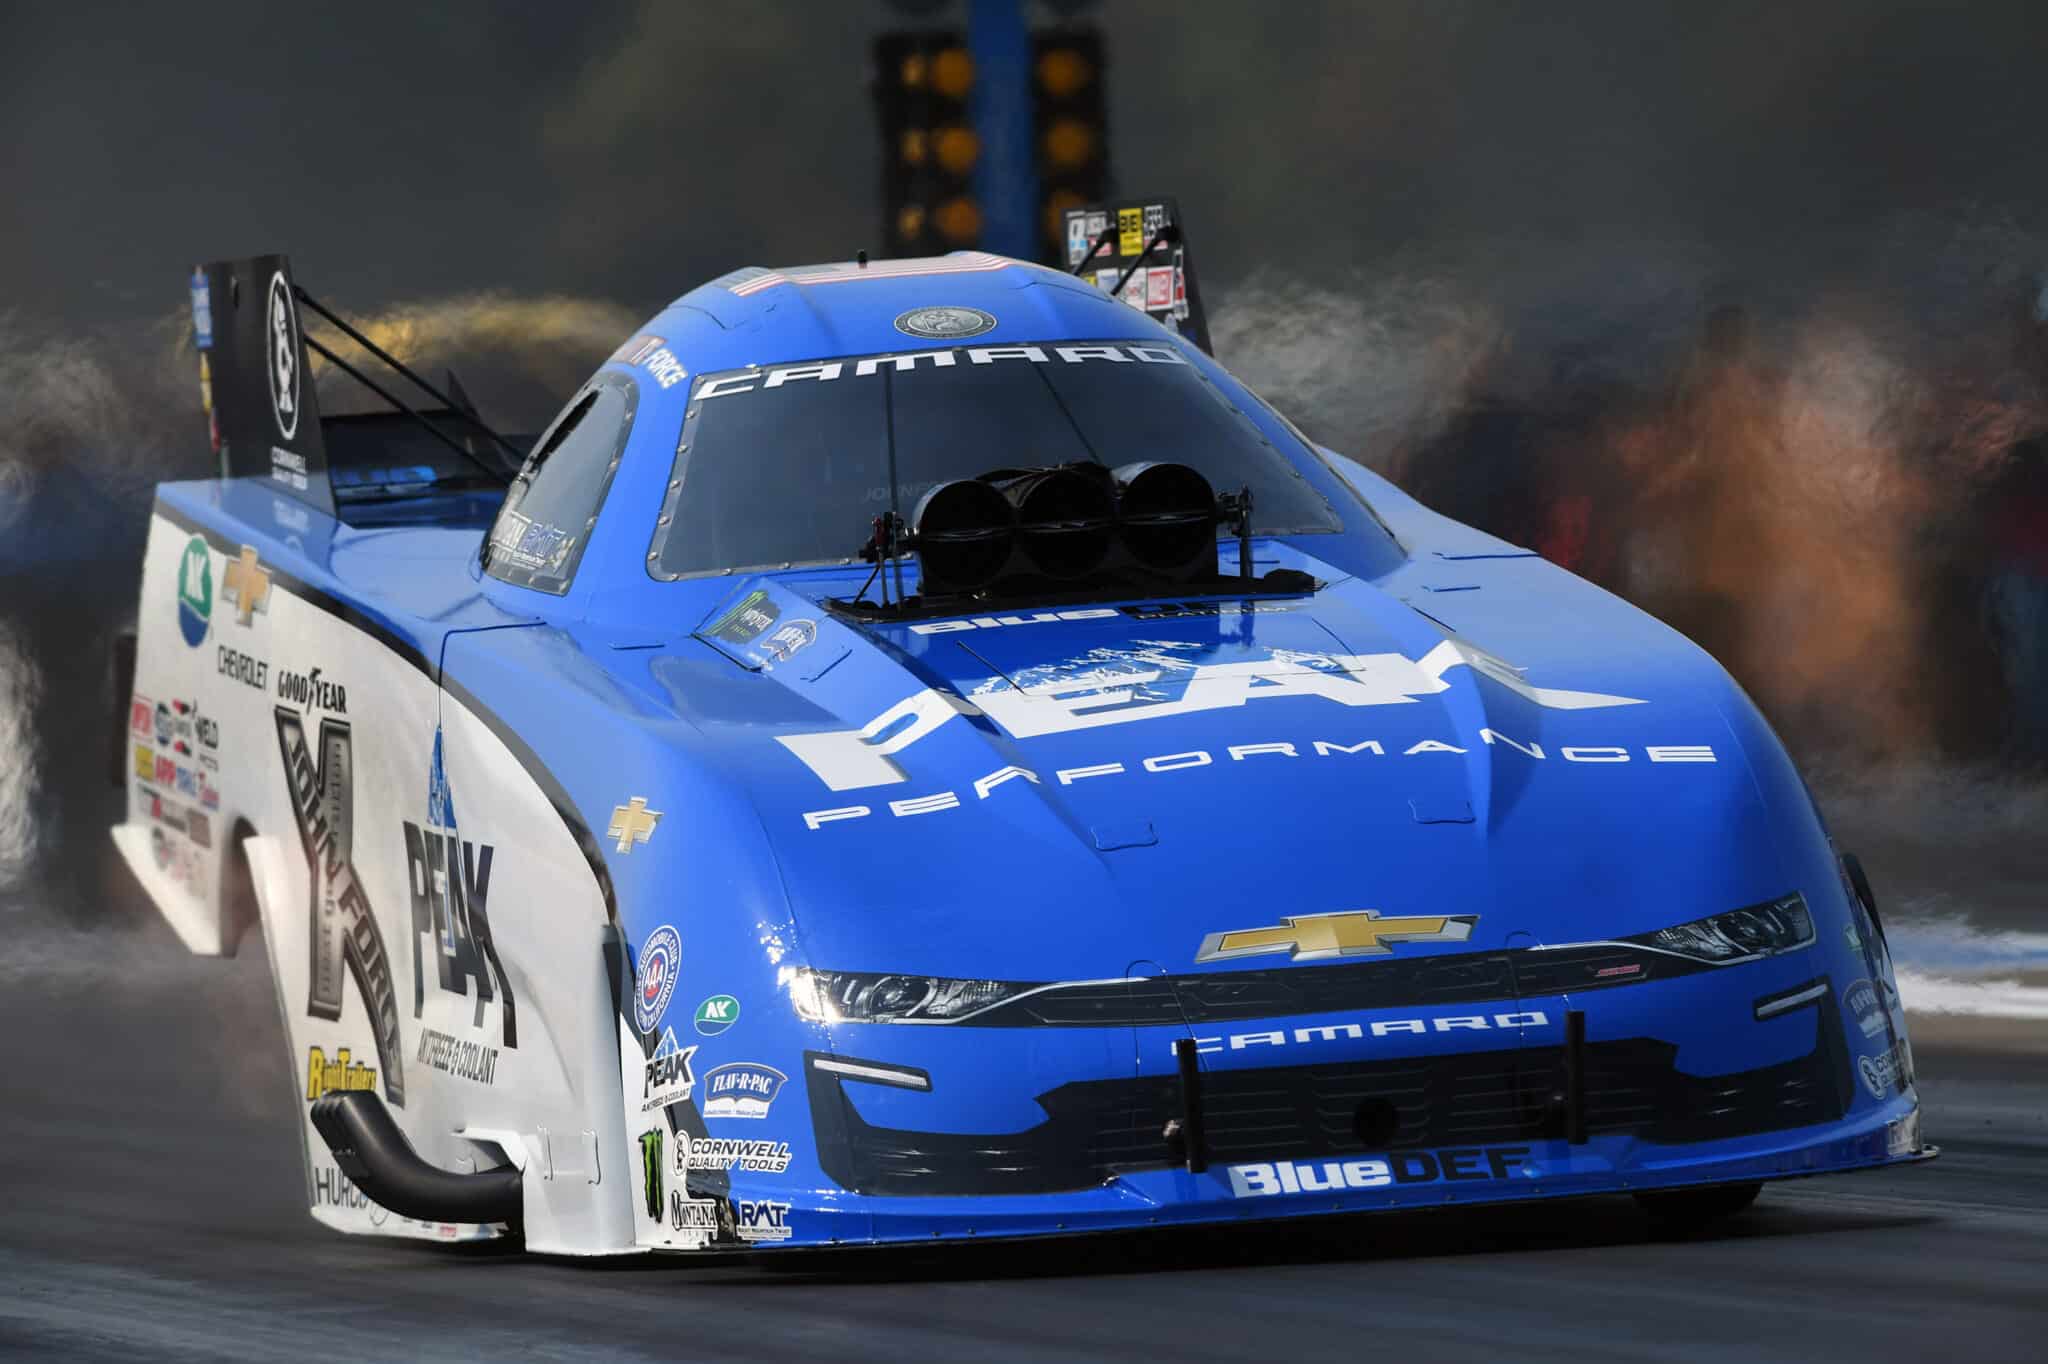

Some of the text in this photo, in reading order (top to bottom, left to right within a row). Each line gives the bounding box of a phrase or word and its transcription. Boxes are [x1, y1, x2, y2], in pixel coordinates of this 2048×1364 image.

[643, 348, 688, 389] FORCE
[693, 345, 1188, 400] CAMARO
[218, 644, 269, 691] CHEVROLET
[803, 728, 1717, 830] PERFORMANCE
[402, 820, 518, 1050] PEAK
[645, 963, 664, 990] AAA
[705, 1001, 732, 1018] AK
[1171, 1010, 1550, 1057] CAMARO
[644, 1051, 691, 1098] PEAK
[688, 1157, 786, 1171] QUALITY TOOLS
[691, 1140, 791, 1159] CORNWELL
[740, 1203, 786, 1227] RMT
